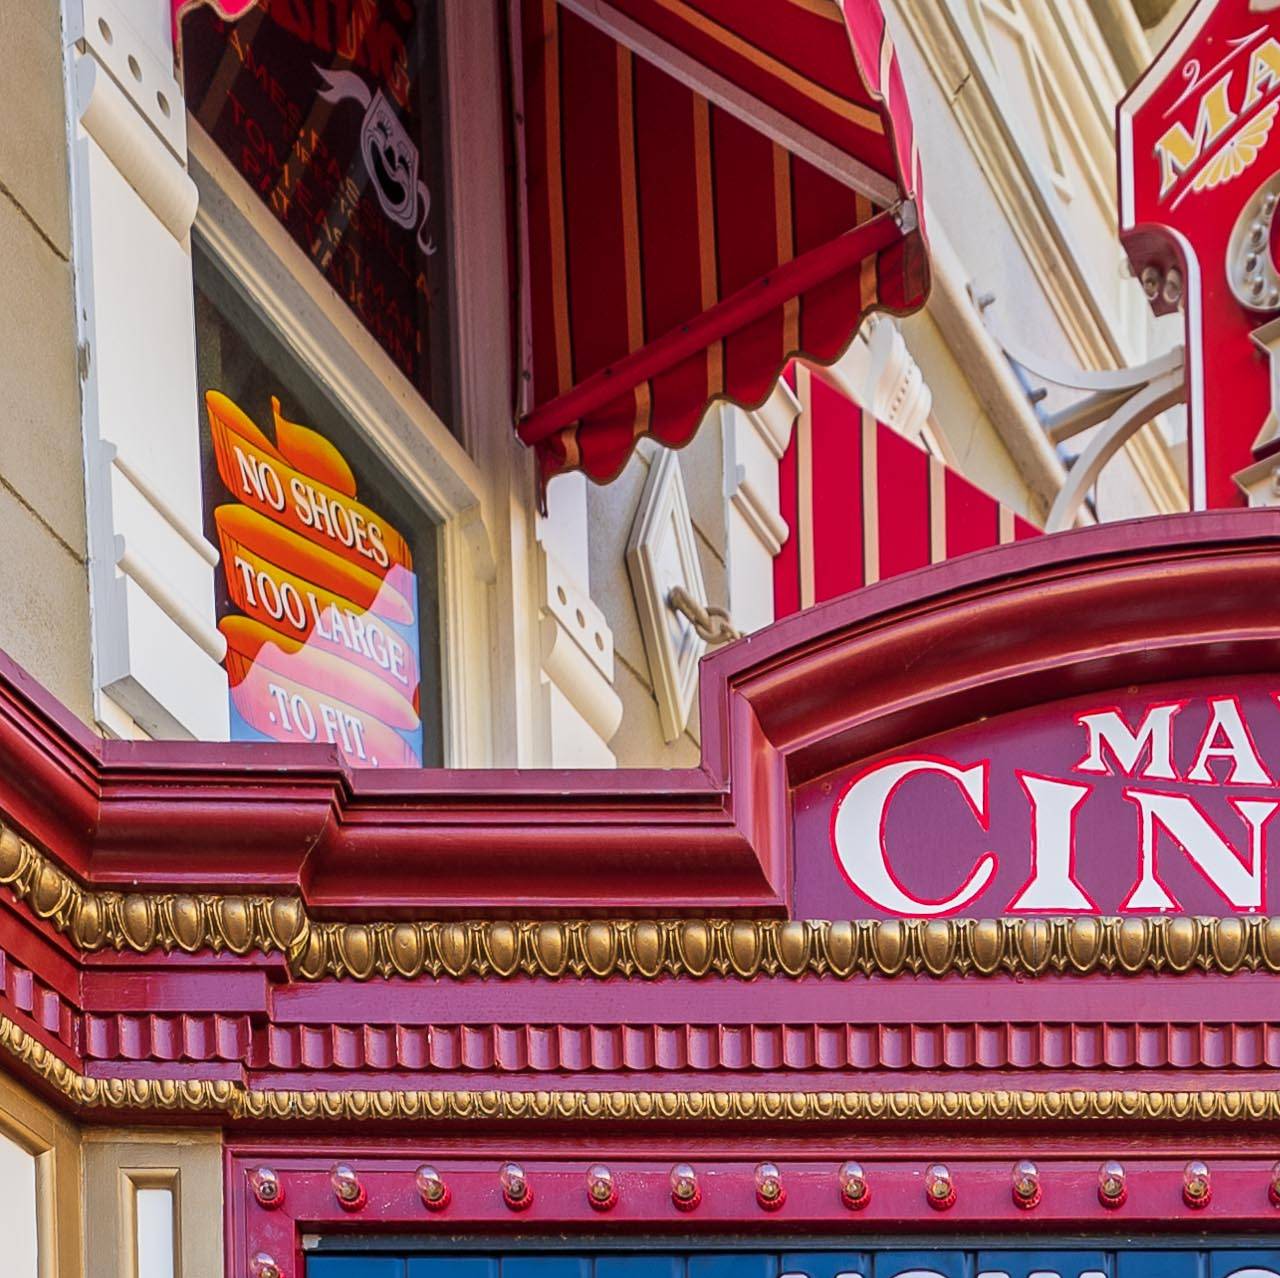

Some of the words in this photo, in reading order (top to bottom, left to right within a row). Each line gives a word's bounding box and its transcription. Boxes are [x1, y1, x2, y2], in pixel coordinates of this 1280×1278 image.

[234, 445, 285, 511] NO
[290, 477, 389, 568] SHOES
[234, 555, 307, 630] TOO
[307, 591, 408, 684] LARGE
